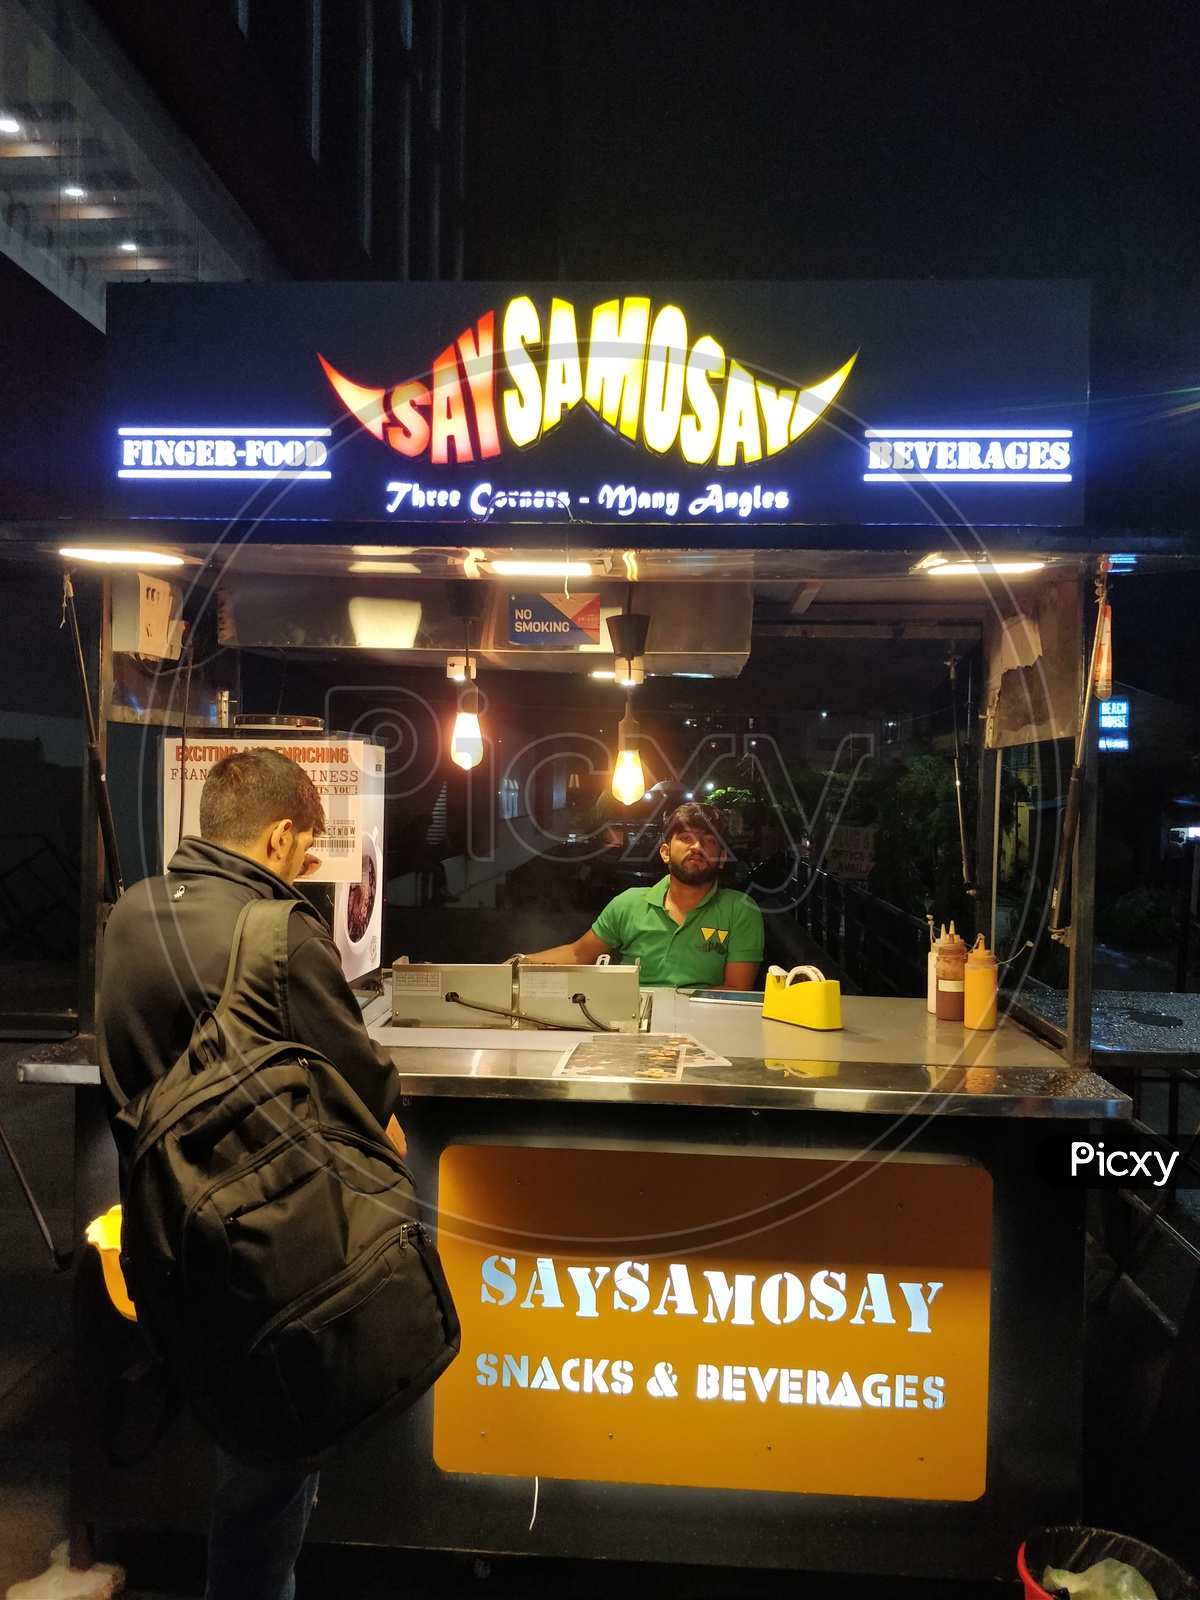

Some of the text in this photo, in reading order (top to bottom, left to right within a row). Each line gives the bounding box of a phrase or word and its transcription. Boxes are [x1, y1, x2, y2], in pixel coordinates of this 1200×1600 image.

[122, 439, 328, 467] FINGER-FOOD
[867, 441, 1072, 470] BEVERAGES
[386, 481, 461, 514] Three
[470, 483, 571, 515] Corners
[598, 484, 680, 516] Many
[688, 483, 790, 517] Angles
[514, 609, 533, 620] NO
[514, 621, 570, 633] SMOKING
[170, 768, 208, 780] FRAN
[305, 770, 359, 782] INESS
[333, 786, 351, 794] YOU
[836, 862, 873, 875] AVAILA
[480, 1254, 944, 1333] SAYSAMOSAY
[476, 1353, 947, 1410] SNACKS & BEVERAGES
